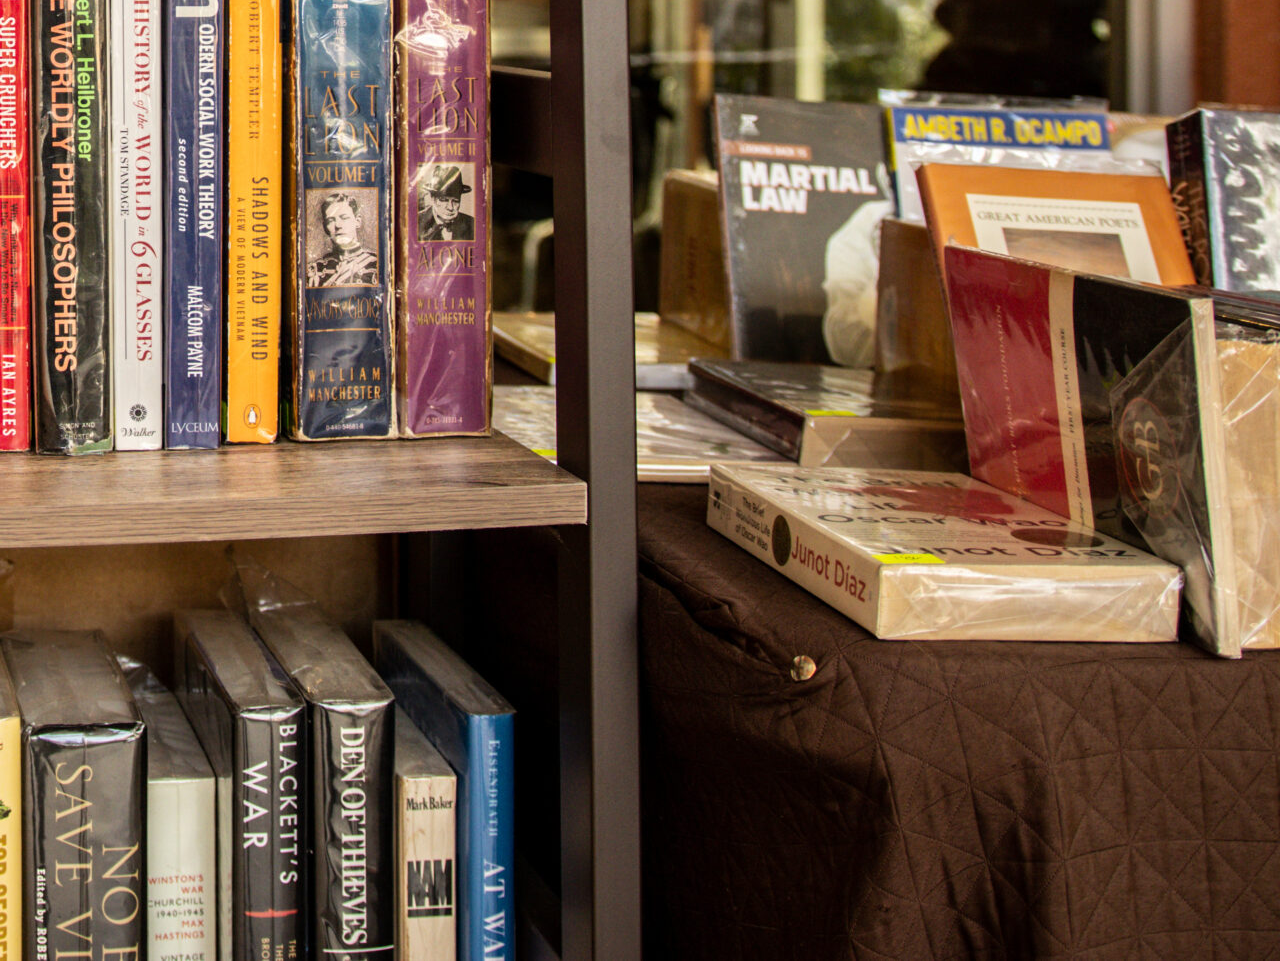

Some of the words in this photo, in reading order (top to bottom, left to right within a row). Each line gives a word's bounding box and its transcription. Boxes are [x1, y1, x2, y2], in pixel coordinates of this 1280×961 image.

[133, 0, 151, 94] HISTORY
[49, 21, 75, 154] WORLDLY
[198, 77, 215, 128] SOCIAL
[76, 57, 95, 162] Heilbroner
[904, 113, 987, 142] AMBETH
[991, 119, 1012, 144] R.
[1015, 119, 1103, 147] OCAMPO
[178, 138, 187, 183] second
[198, 132, 215, 178] WORK
[417, 142, 465, 157] VOLUME
[134, 133, 152, 221] WORLD
[308, 167, 367, 183] VOLUME
[740, 160, 878, 195] MARTIAL
[178, 186, 189, 232] edition
[198, 182, 216, 239] THEORY
[251, 176, 269, 260] SHADOWS
[742, 187, 808, 214] LAW
[978, 211, 1021, 223] GREAT
[1026, 214, 1095, 226] AMERICAN
[1098, 217, 1140, 229] POETS
[51, 162, 78, 373] PHILOSOPHERS
[130, 240, 158, 258] 6
[251, 270, 269, 305] AND
[417, 298, 476, 310] WILLIAM
[136, 262, 153, 362] GLASSES
[187, 285, 204, 338] MALCOM
[417, 312, 476, 326] MANCHESTER
[251, 316, 269, 361] WIND
[2, 354, 16, 380] IAN
[186, 342, 204, 378] PAYNE
[308, 368, 381, 381] WILLIAM
[308, 385, 381, 401] MANCHESTER
[2, 388, 16, 437] AYRES
[171, 422, 218, 433] LYCEUM
[120, 427, 157, 438] Walker
[791, 536, 830, 580] Junot
[340, 726, 365, 782] DEN
[242, 760, 268, 849] WAR
[279, 723, 298, 885] BLACKETT'S
[340, 787, 366, 825] OF
[406, 797, 429, 811] Mark
[429, 796, 453, 810] Baker
[54, 762, 94, 887] SAVE
[181, 885, 204, 894] WAR
[341, 827, 367, 945] THIEVES
[483, 859, 505, 897] AT
[156, 909, 204, 918] 1940-1945
[181, 919, 204, 928] MAX
[154, 931, 204, 941] HASTINGS
